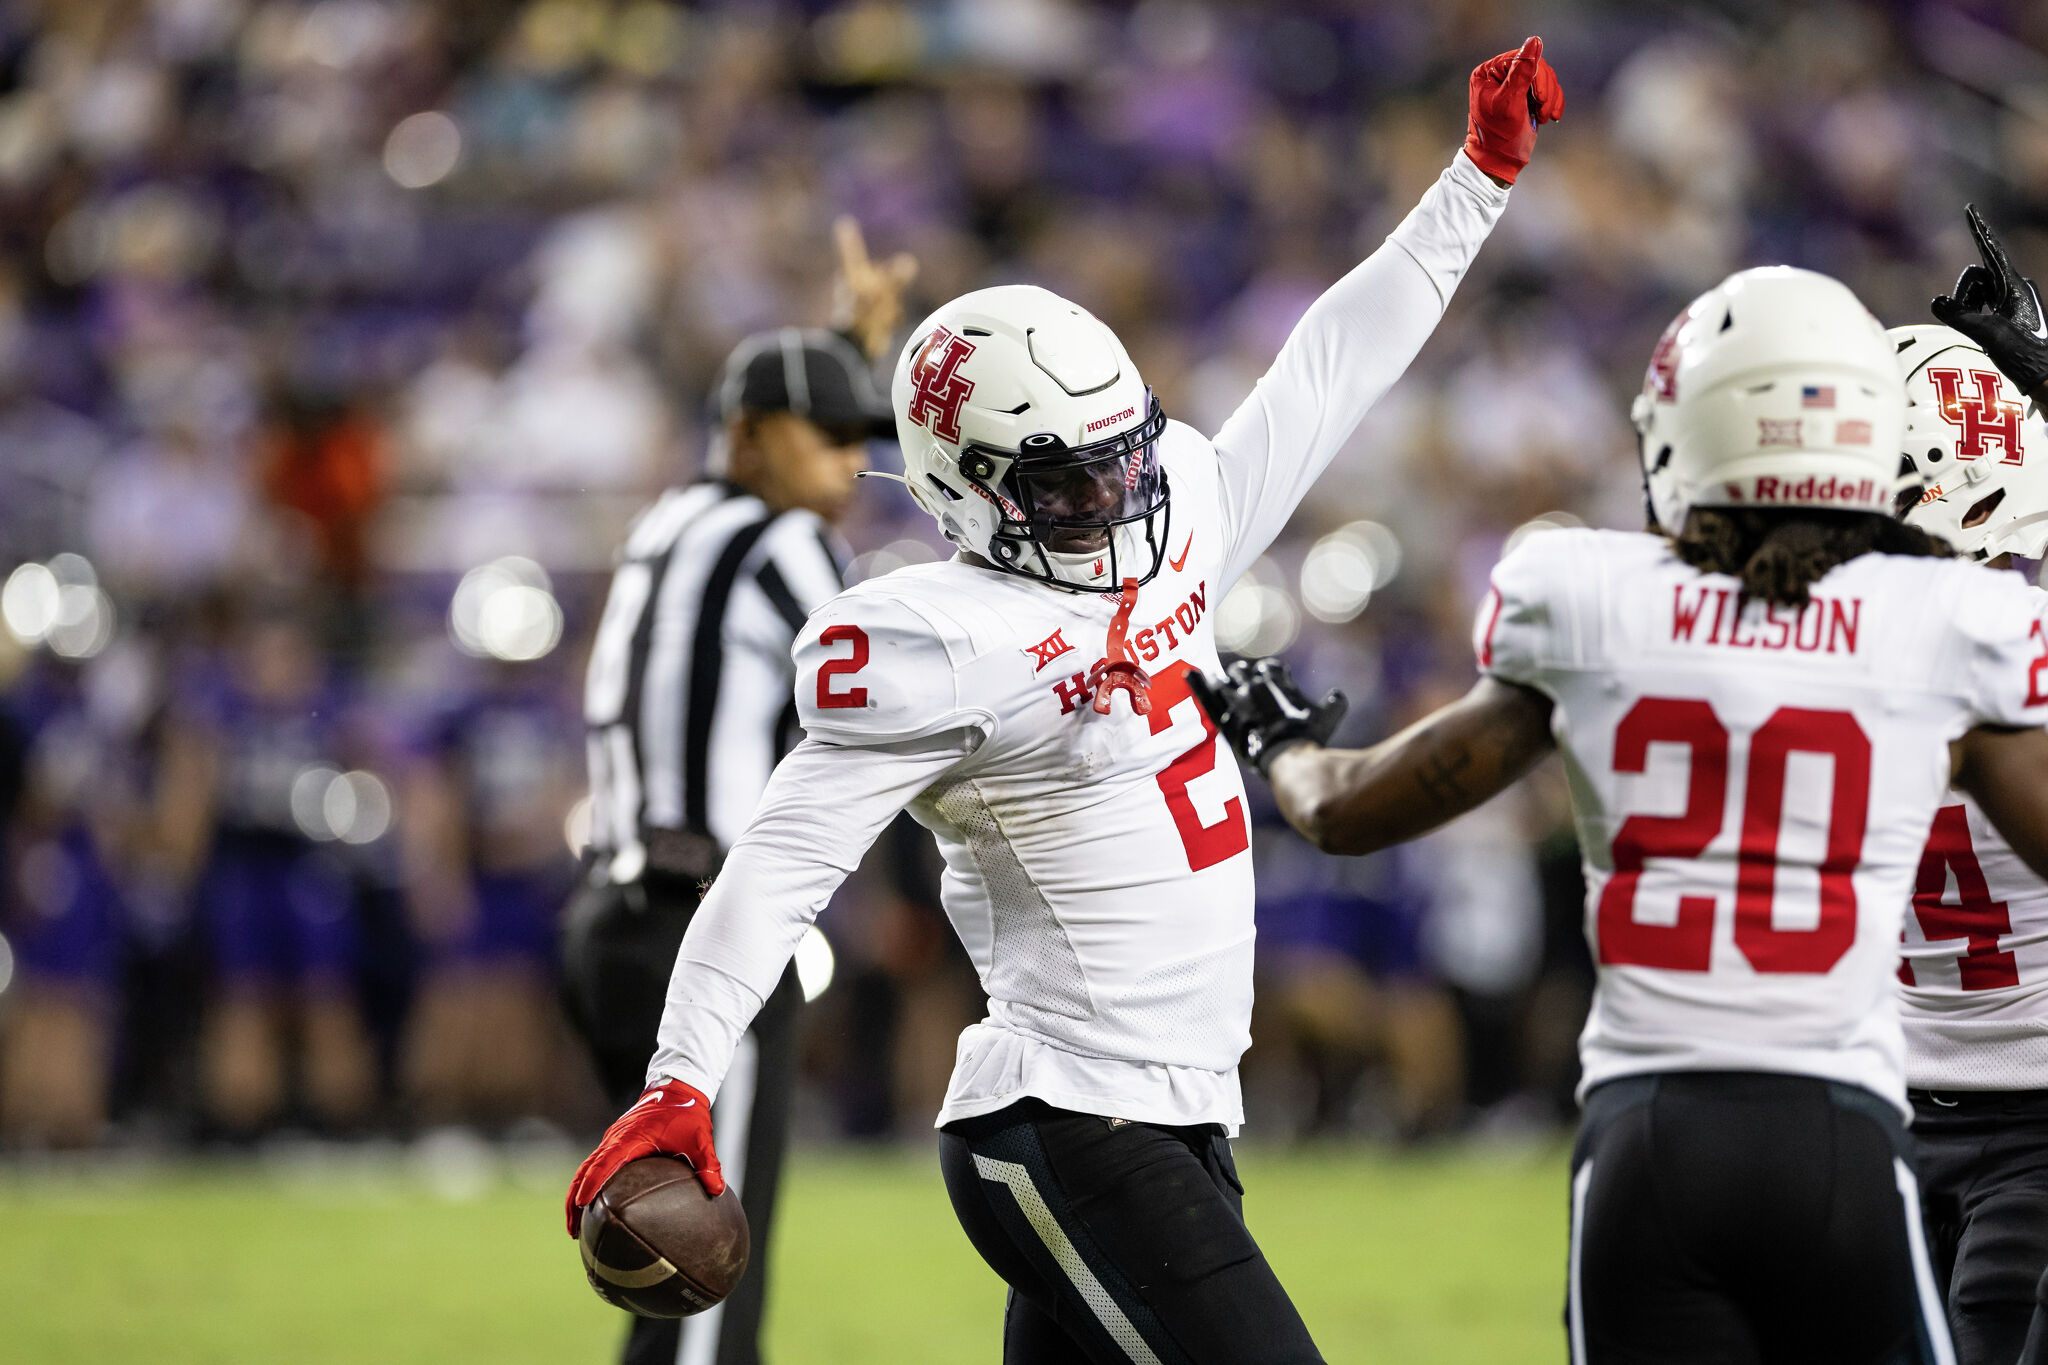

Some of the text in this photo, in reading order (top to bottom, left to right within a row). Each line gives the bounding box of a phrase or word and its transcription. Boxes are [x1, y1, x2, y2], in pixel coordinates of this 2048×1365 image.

[908, 325, 977, 445] UH
[1086, 406, 1135, 433] HOUSTON
[1928, 367, 2024, 466] UH
[1755, 475, 1874, 503] Riddell
[1025, 627, 1076, 673] XII
[1671, 583, 1862, 656] WILSON
[816, 624, 870, 709] 2
[1146, 658, 1249, 872] 2
[1597, 695, 1873, 974] 20
[1896, 803, 2020, 991] 4
